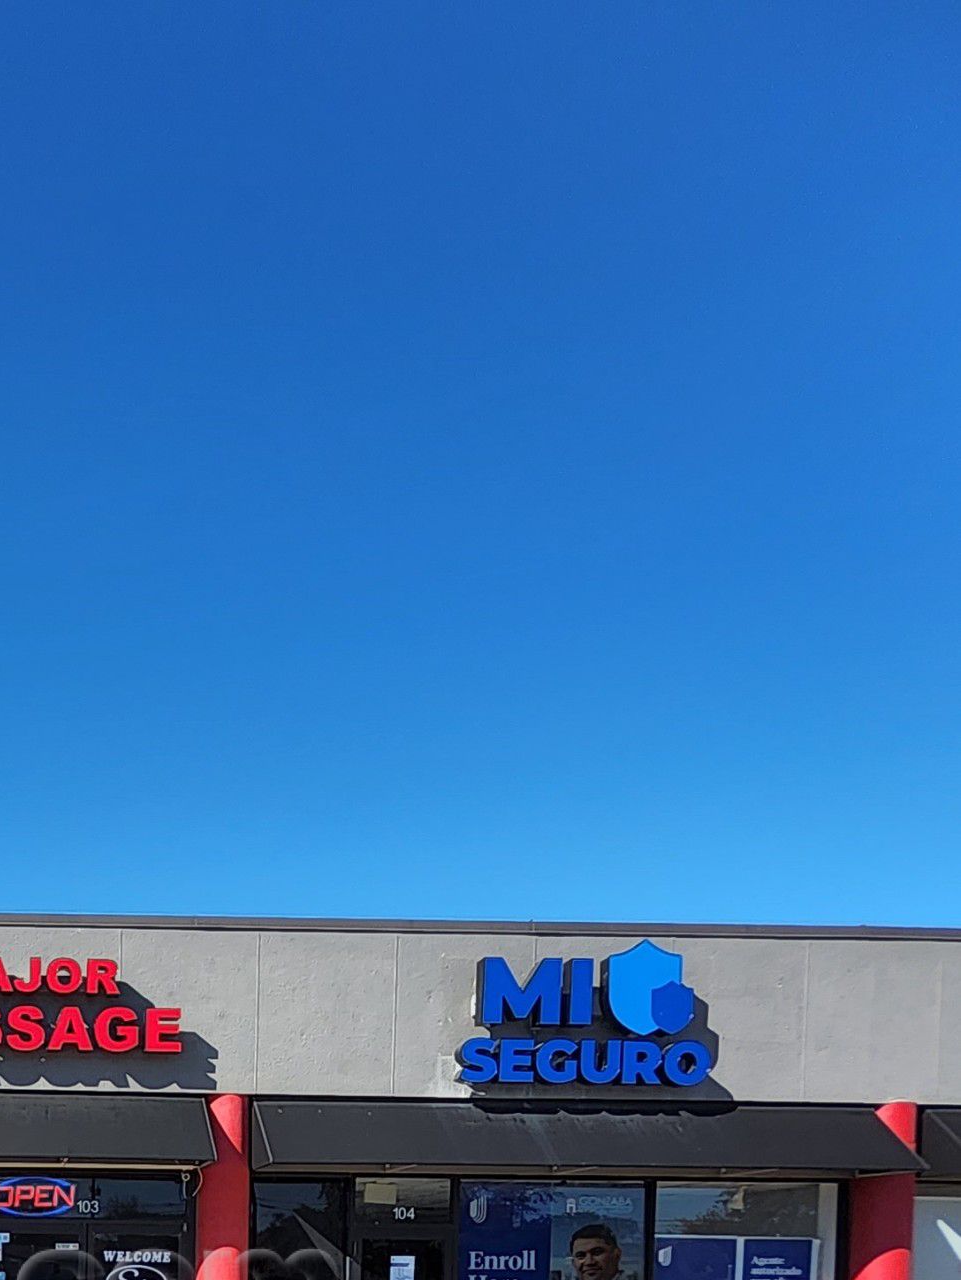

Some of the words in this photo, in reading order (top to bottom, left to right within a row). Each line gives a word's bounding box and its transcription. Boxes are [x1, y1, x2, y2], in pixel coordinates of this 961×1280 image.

[481, 956, 594, 1025] MI
[459, 1038, 712, 1086] SEGURO
[77, 1200, 99, 1213] 103
[392, 1207, 416, 1220] 104
[103, 1250, 172, 1263] WELCOME
[467, 1250, 536, 1271] Enroll
